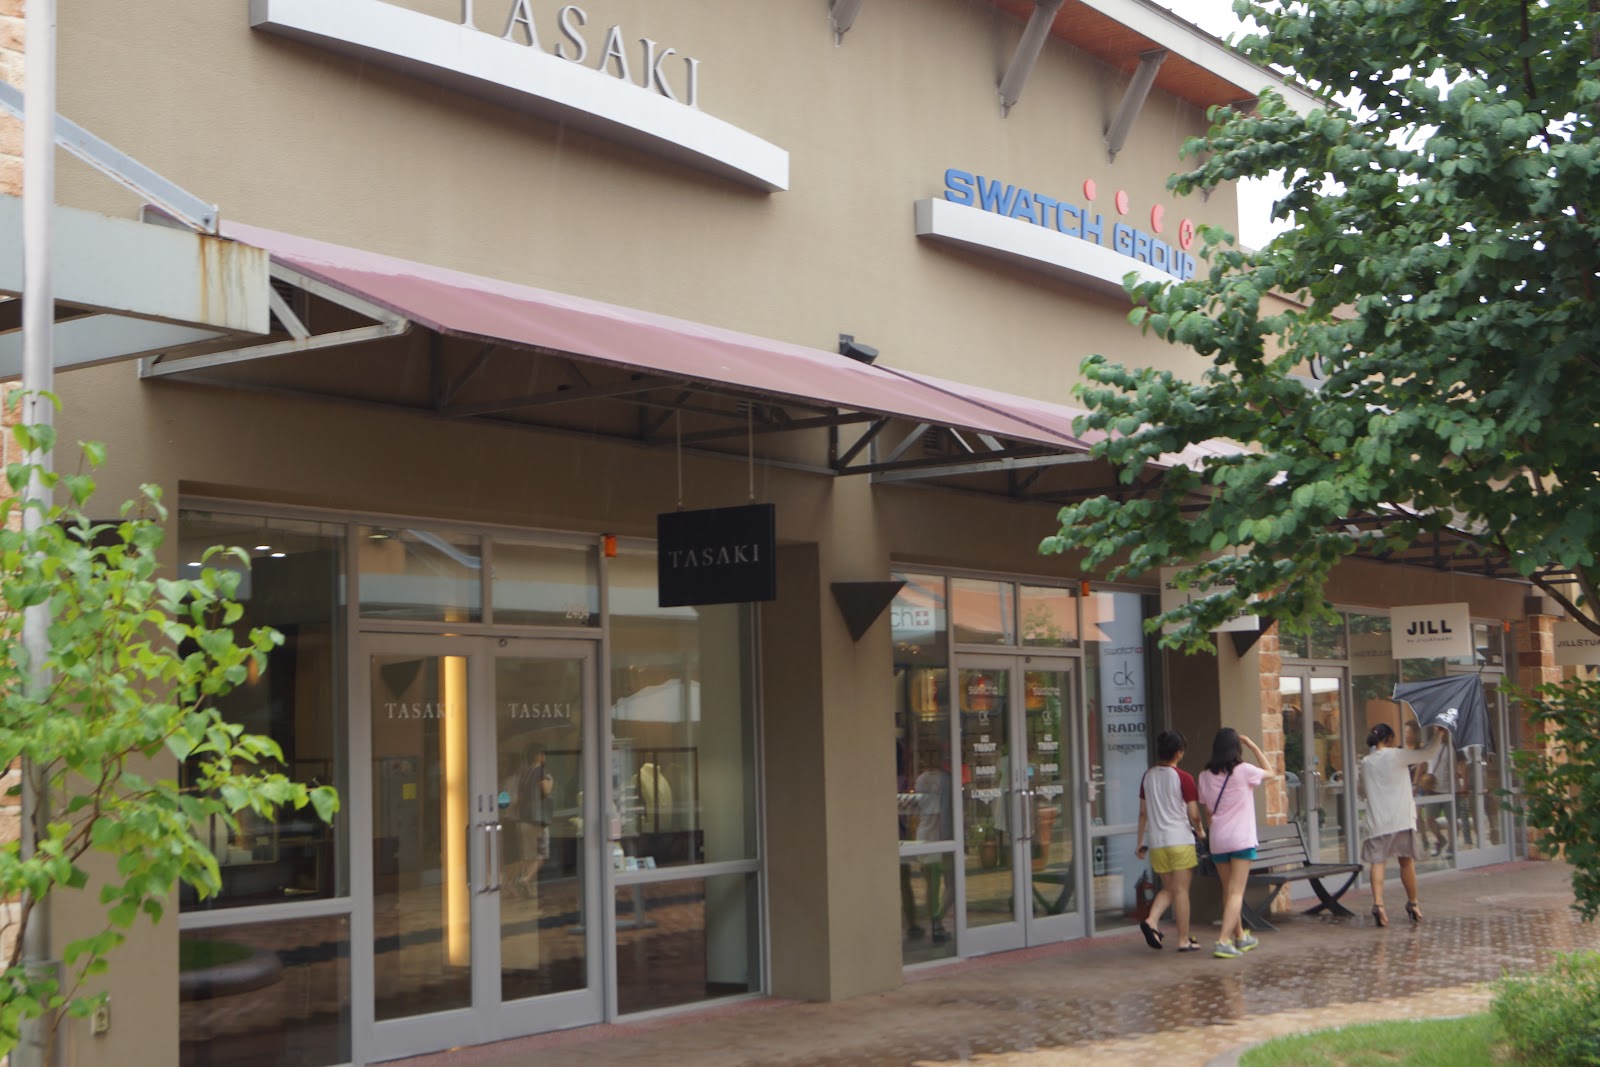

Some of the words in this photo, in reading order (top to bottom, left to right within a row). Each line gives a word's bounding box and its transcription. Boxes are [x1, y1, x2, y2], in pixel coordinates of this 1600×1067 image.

[944, 168, 1104, 247] SWATCH
[1113, 222, 1197, 280] GROUP
[667, 544, 760, 569] TASAKI
[1407, 620, 1452, 636] JILL
[1113, 661, 1136, 686] ck
[384, 702, 455, 720] TASAKI
[508, 702, 572, 719] TASAKI
[1107, 704, 1144, 713] TISSOT
[1108, 722, 1146, 733] RADO
[973, 743, 996, 752] TISSOT
[976, 766, 996, 775] RADO
[1040, 763, 1058, 773] RADO
